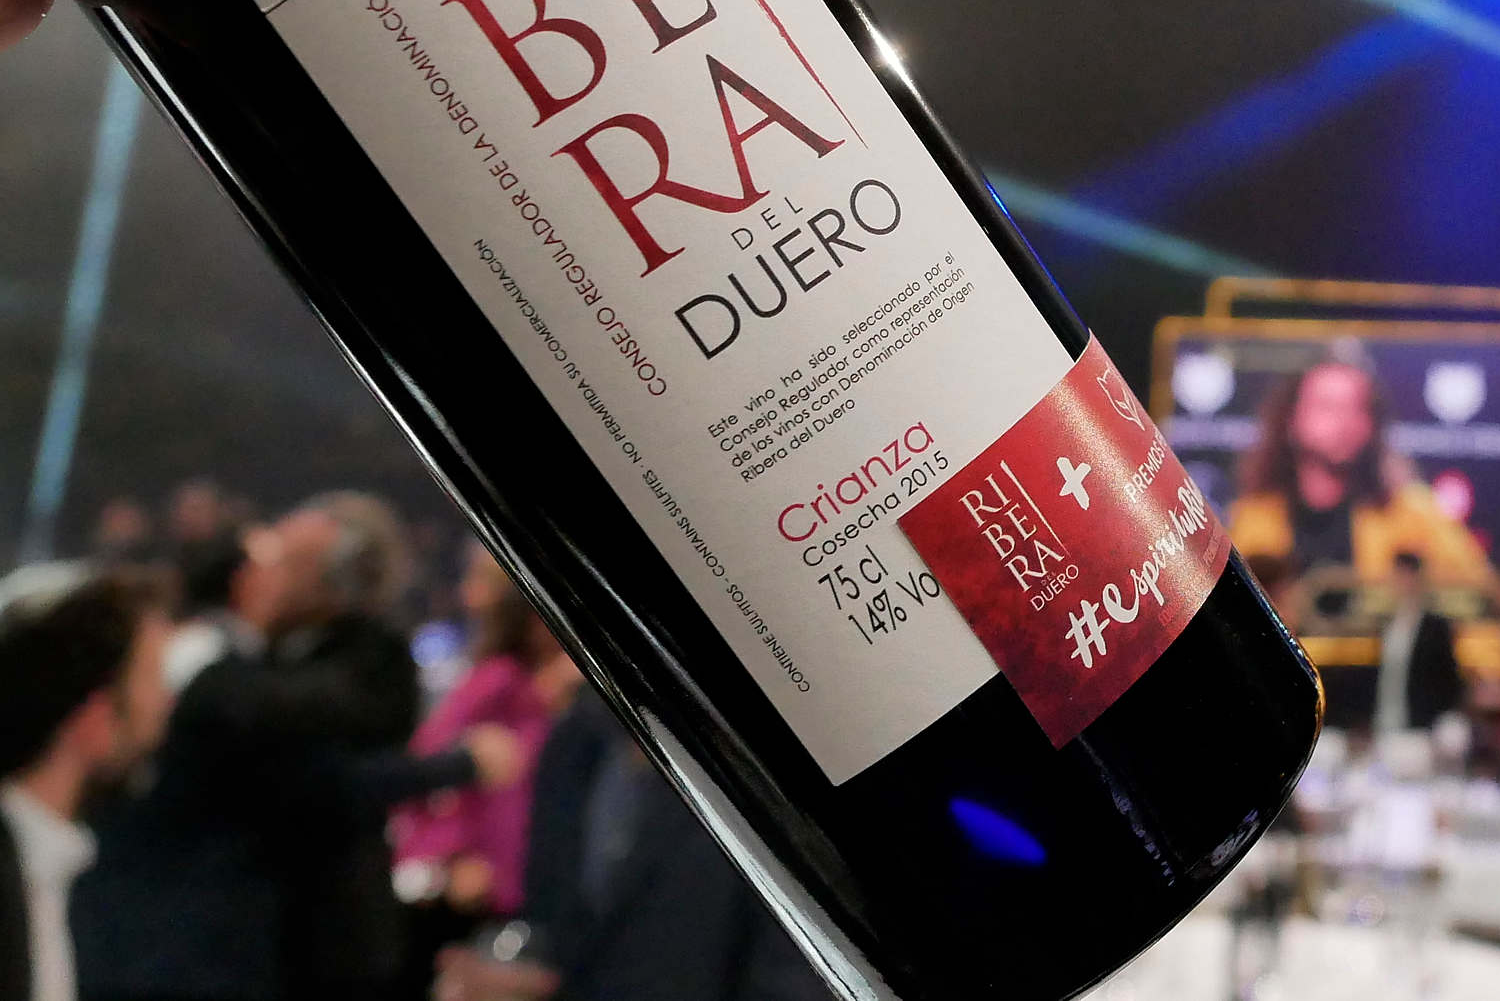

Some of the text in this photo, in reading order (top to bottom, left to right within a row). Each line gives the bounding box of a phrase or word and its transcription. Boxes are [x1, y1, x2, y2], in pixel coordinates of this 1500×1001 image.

[473, 132, 499, 163] LA
[488, 159, 519, 191] DE
[549, 12, 846, 279] RA
[511, 188, 603, 307] REGULADOR
[730, 196, 804, 251] DEL
[473, 238, 568, 362] COMERCIALIZACIÓN
[673, 179, 902, 362] DUERO
[562, 361, 581, 380] SU
[596, 306, 667, 397] CONSEJO
[707, 250, 956, 439] Este vino ha sido seleccionado por el
[719, 268, 965, 452] Consejo Regulador como representación
[731, 281, 975, 468] de los vinos con Denominación de Origen
[577, 377, 627, 443] PERMITIDA
[740, 399, 856, 484] Ribera del Duero
[621, 441, 643, 464] NO
[777, 421, 935, 543] Crianza
[1123, 443, 1167, 504] PREMIOS
[641, 469, 682, 518] SULFITES
[802, 449, 949, 567] Cosecha 2015
[676, 516, 725, 577] CONTAINS
[817, 544, 889, 611] 75 cl
[725, 583, 769, 635] SULFITOS
[847, 571, 941, 646] 14% Vo
[1029, 564, 1079, 612] DUERO
[761, 633, 811, 693] CONTIENE
